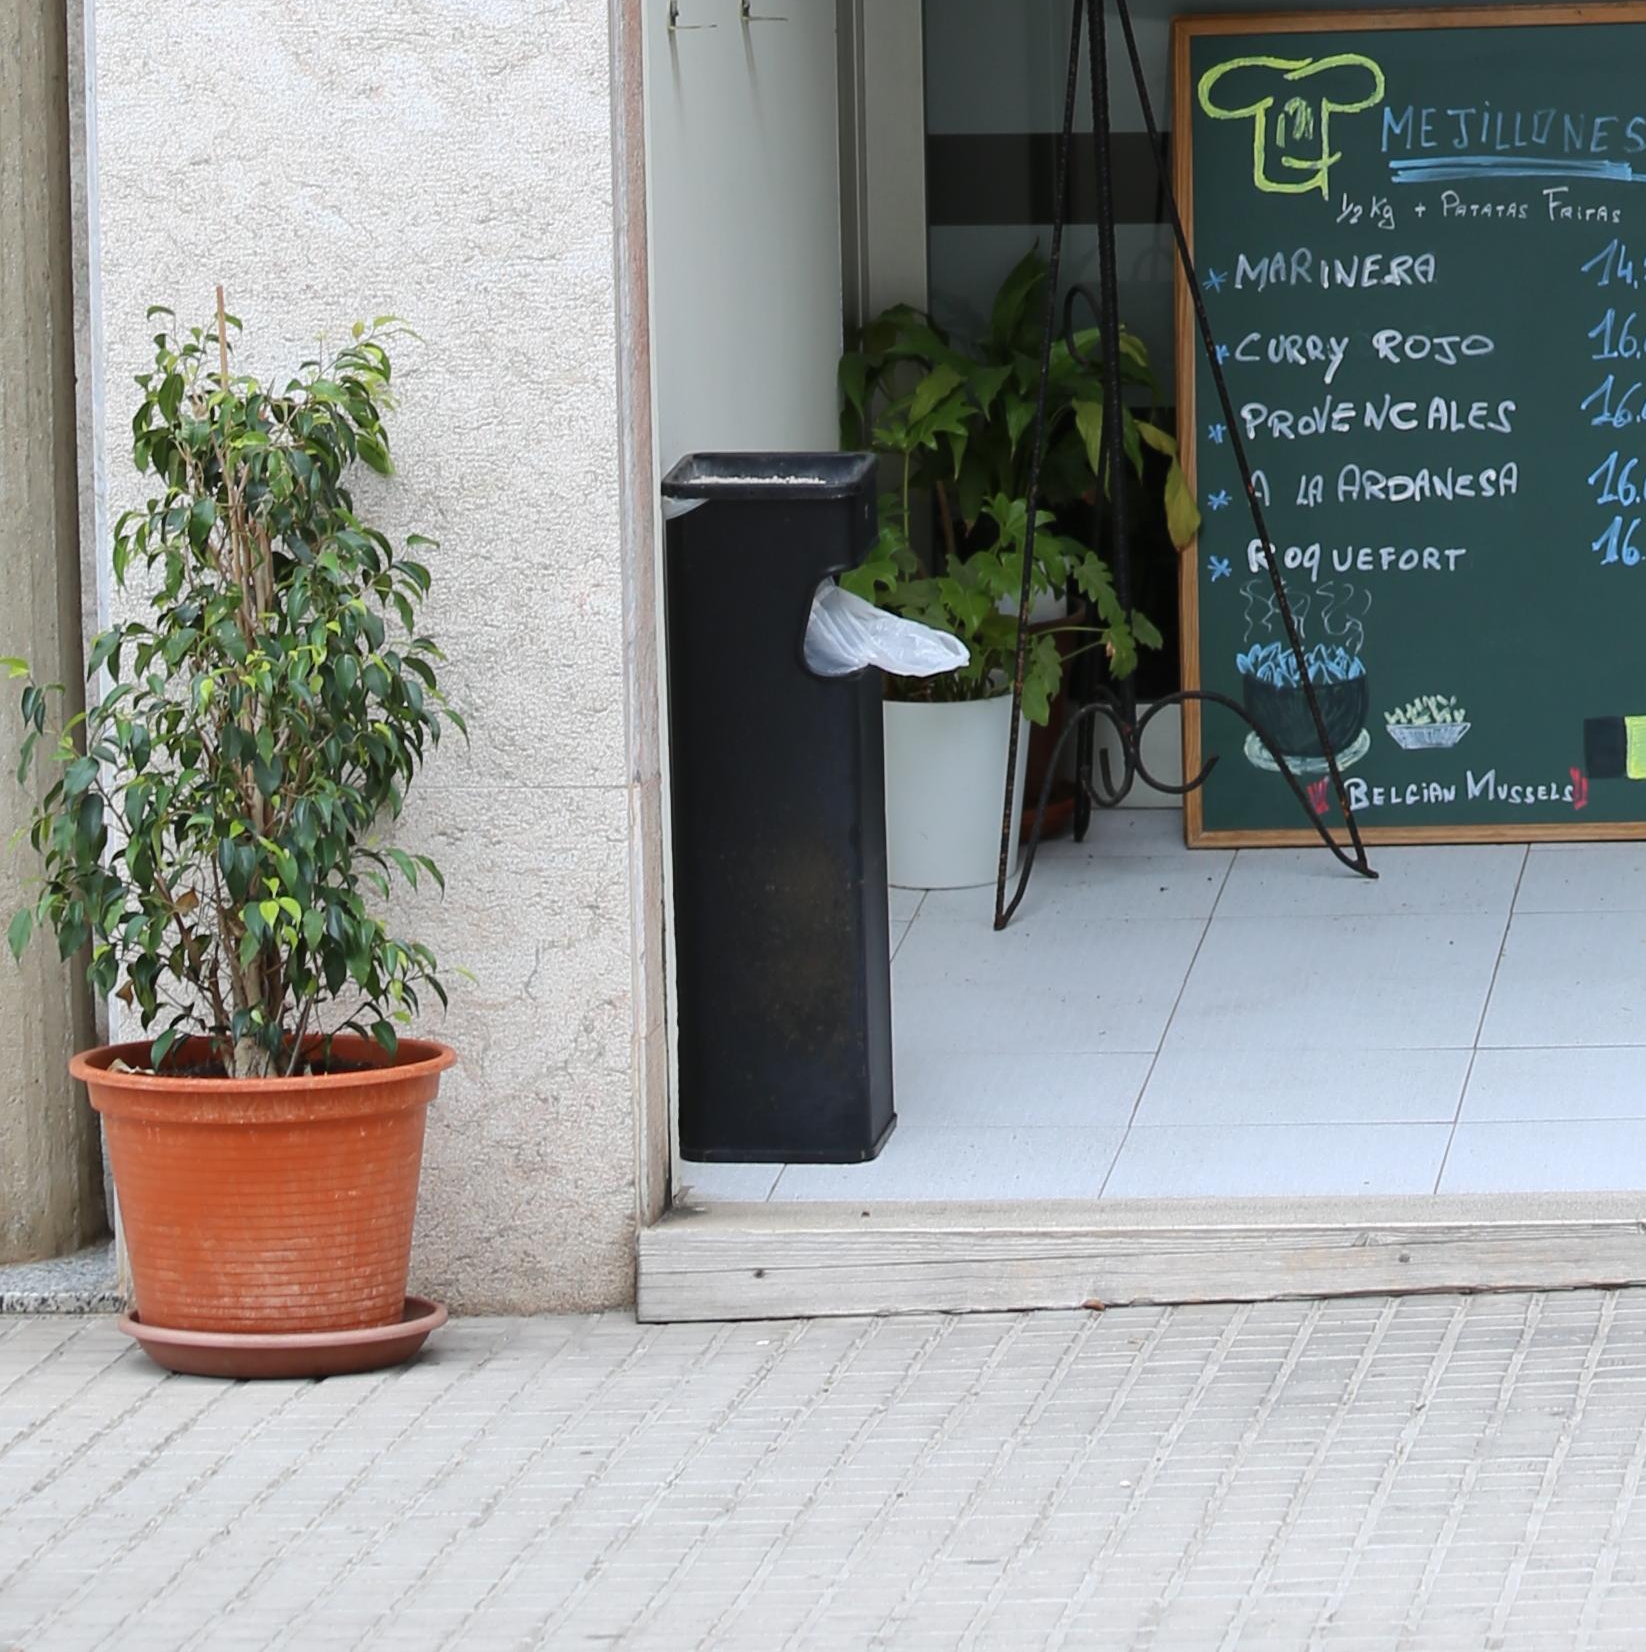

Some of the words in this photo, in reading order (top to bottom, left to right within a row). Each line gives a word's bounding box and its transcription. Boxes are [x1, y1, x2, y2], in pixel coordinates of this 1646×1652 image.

[1235, 248, 1436, 293] MARINERA
[1235, 332, 1349, 384] CURRY
[1373, 329, 1494, 365] ROJO
[1240, 394, 1517, 439] PROVENCALES
[1250, 469, 1271, 508] A
[1296, 472, 1323, 505] LA
[1338, 462, 1519, 501] ARDANESA
[1247, 539, 1467, 582] ROQUEFORT
[1465, 769, 1574, 803] MUSSELS
